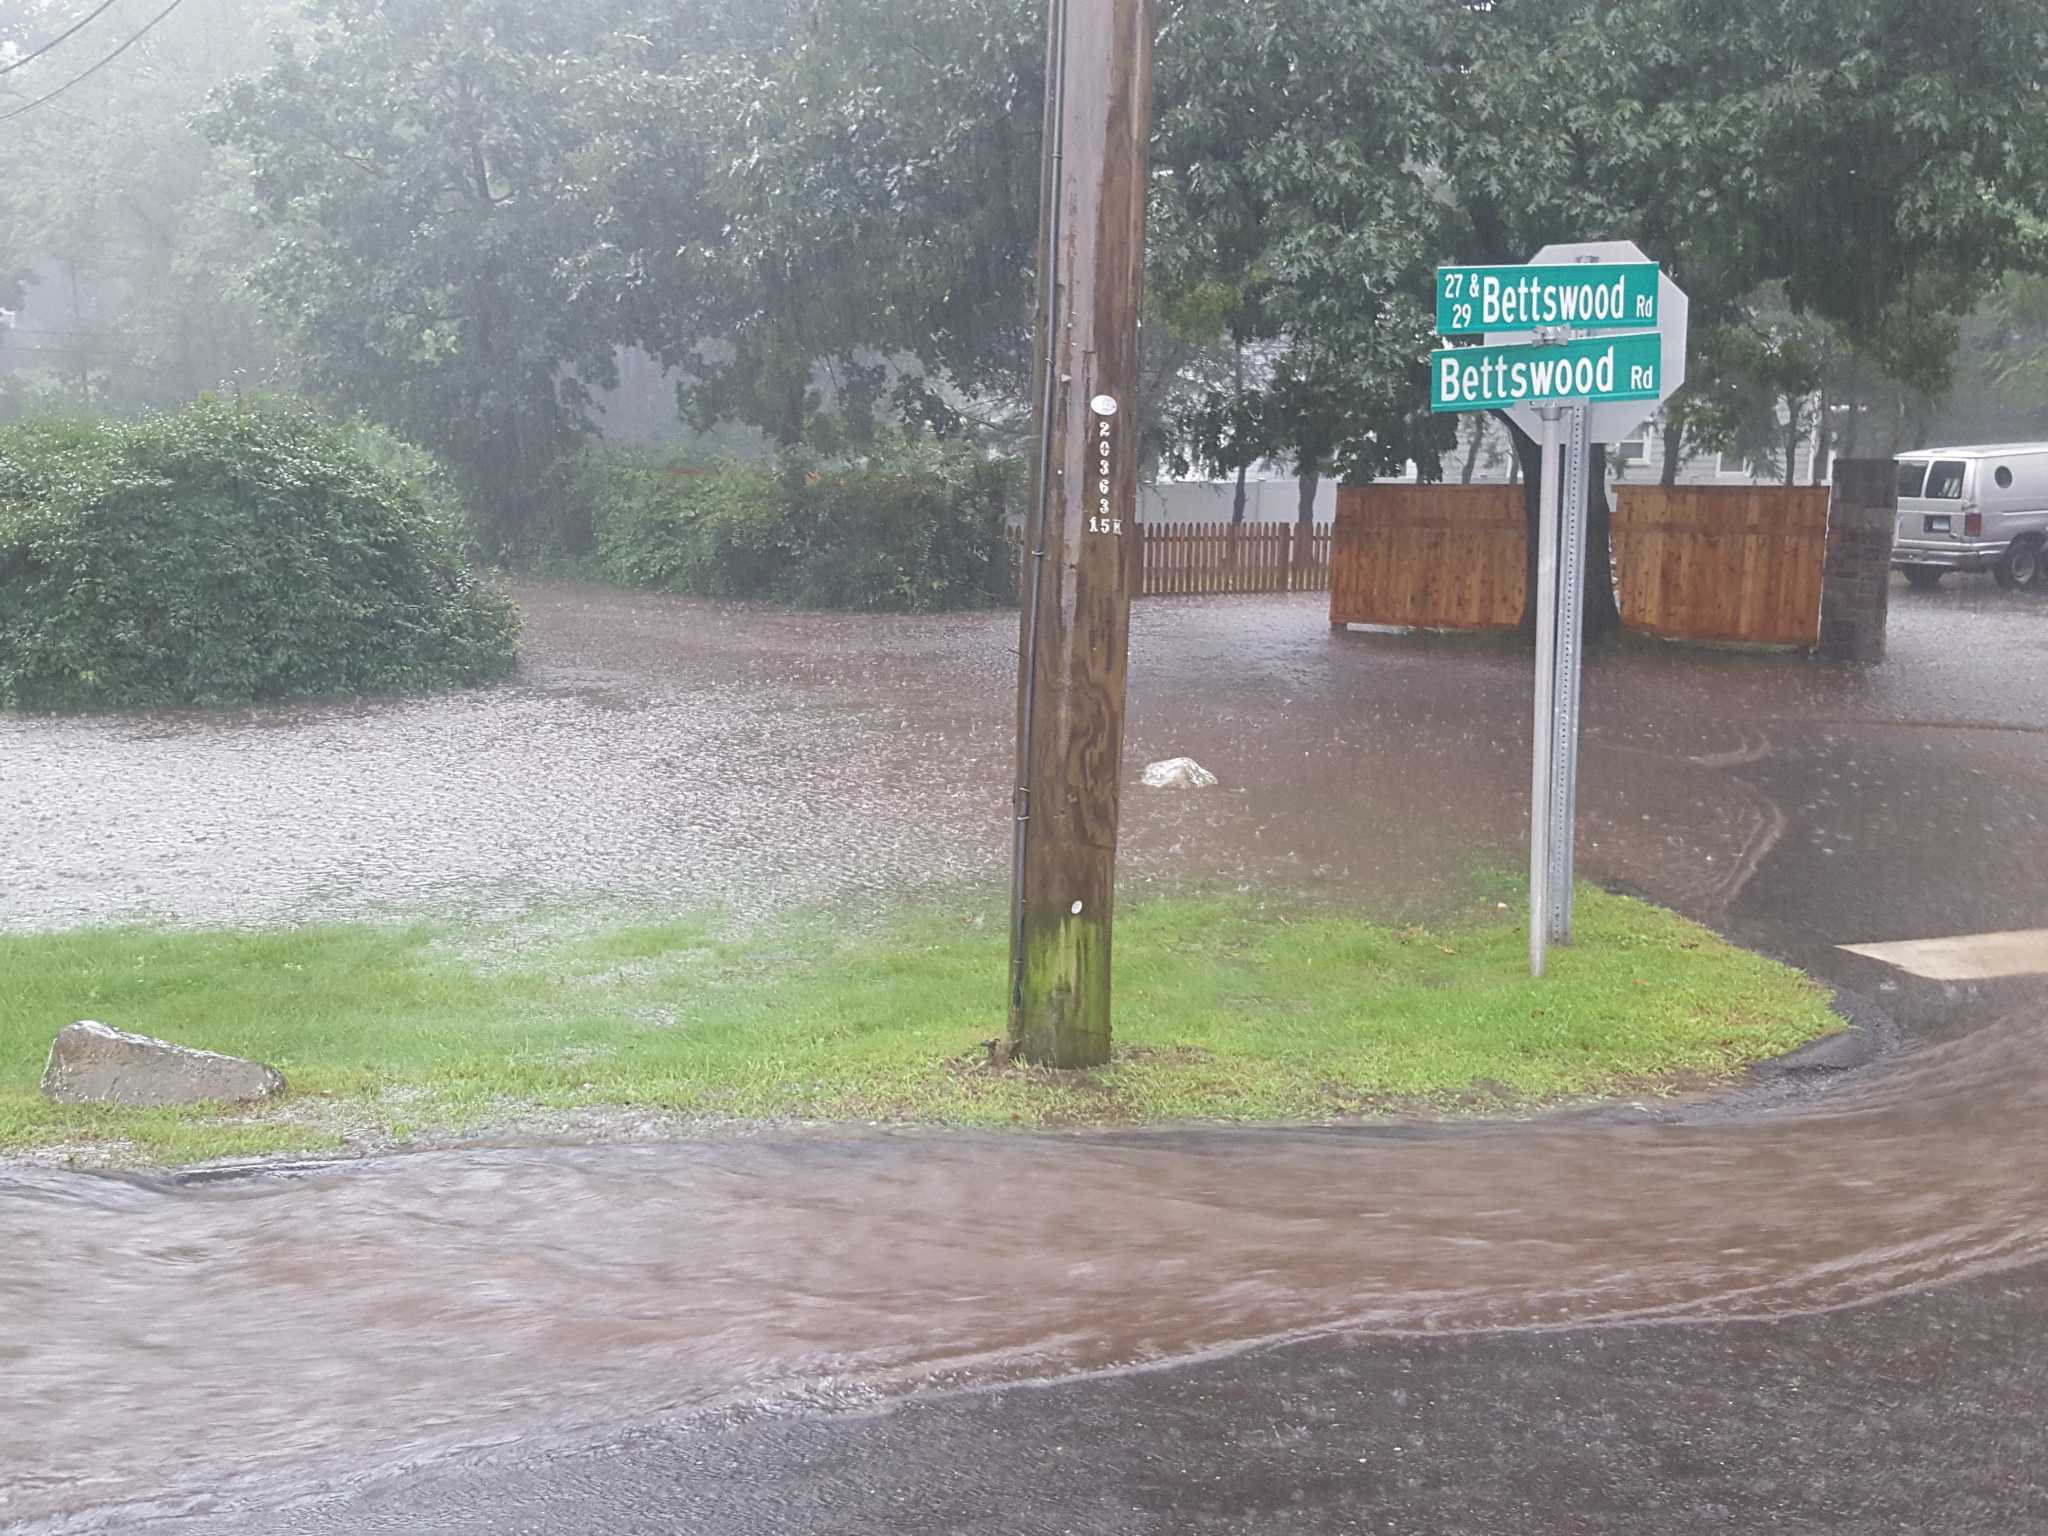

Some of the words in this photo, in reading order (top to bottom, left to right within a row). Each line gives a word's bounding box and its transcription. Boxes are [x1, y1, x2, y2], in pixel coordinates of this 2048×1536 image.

[1444, 274, 1463, 299] 27
[1469, 273, 1480, 297] &
[1483, 274, 1625, 323] Bettswood
[1636, 294, 1653, 318] Rd
[1452, 303, 1472, 328] 29
[1441, 345, 1613, 401] Bettswood
[1630, 365, 1653, 390] Rd
